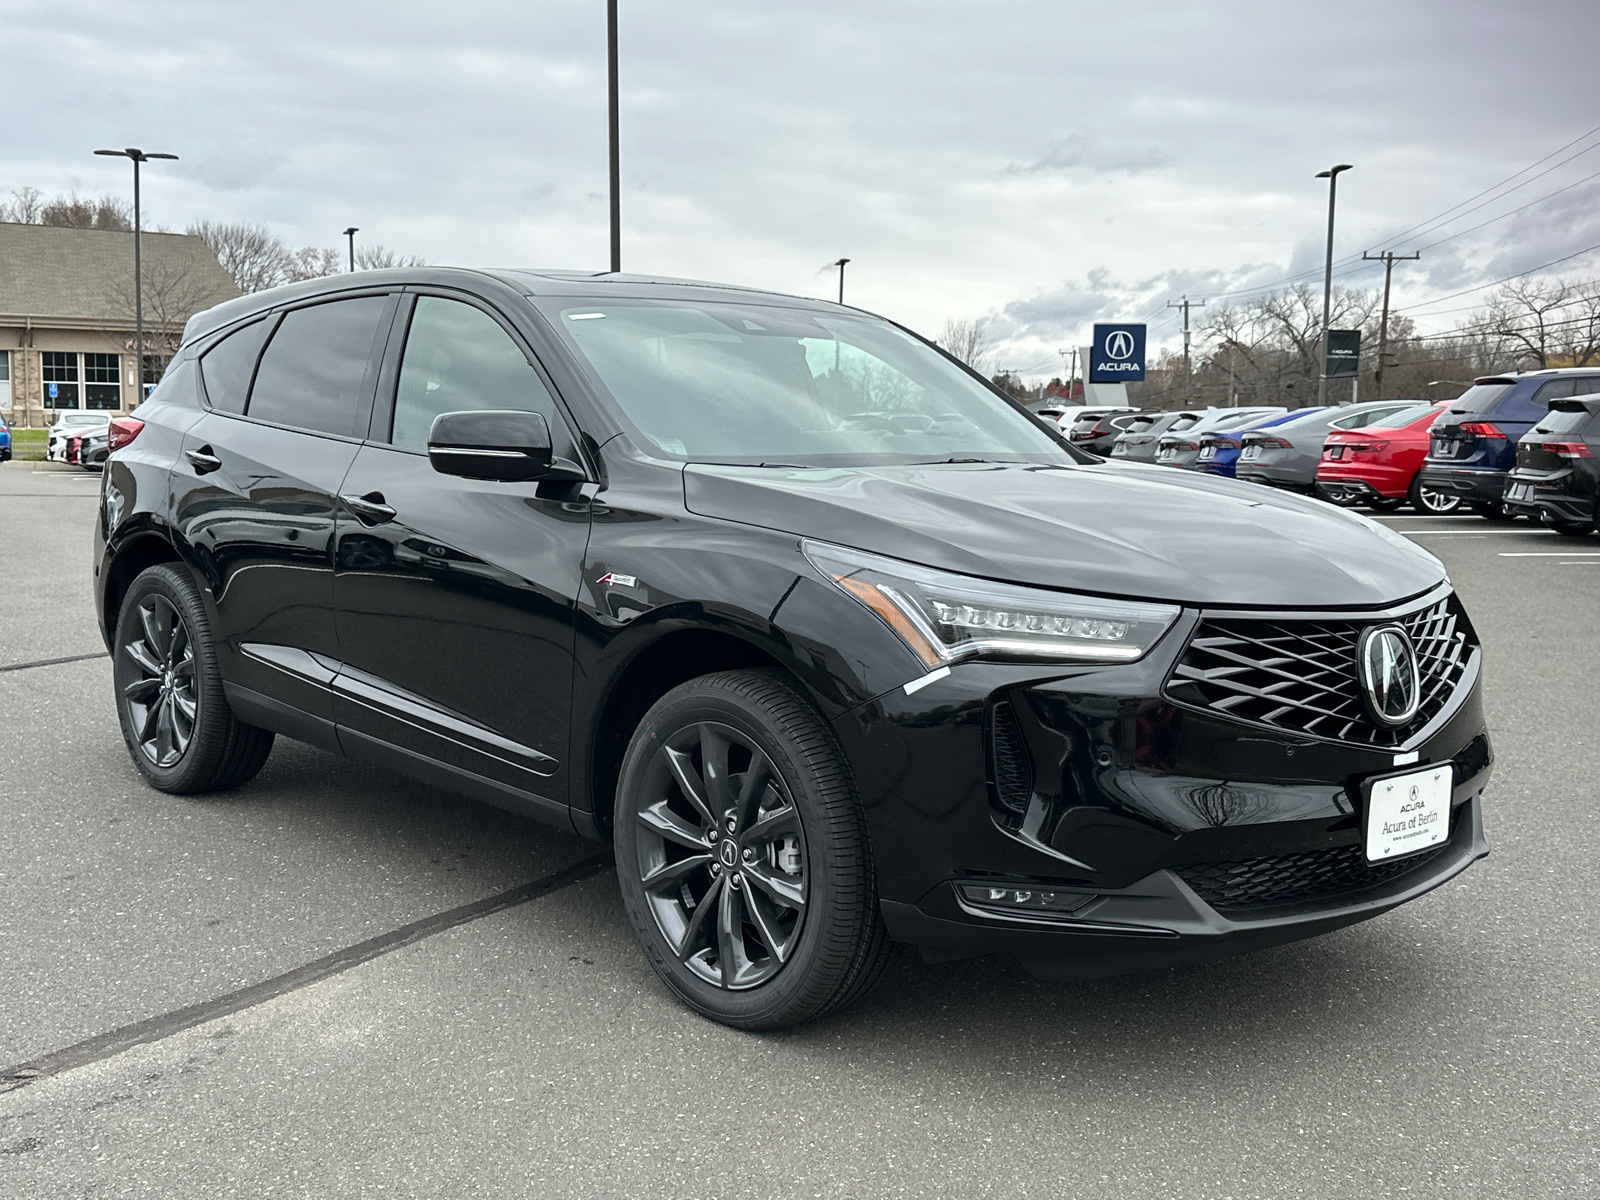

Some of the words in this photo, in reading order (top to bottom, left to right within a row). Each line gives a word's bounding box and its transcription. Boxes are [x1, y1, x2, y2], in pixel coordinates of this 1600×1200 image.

[1097, 362, 1140, 371] ACURA
[1400, 801, 1425, 814] ACURA
[1382, 821, 1406, 835] Acura
[1408, 817, 1417, 829] of
[1418, 810, 1438, 826] Berlin
